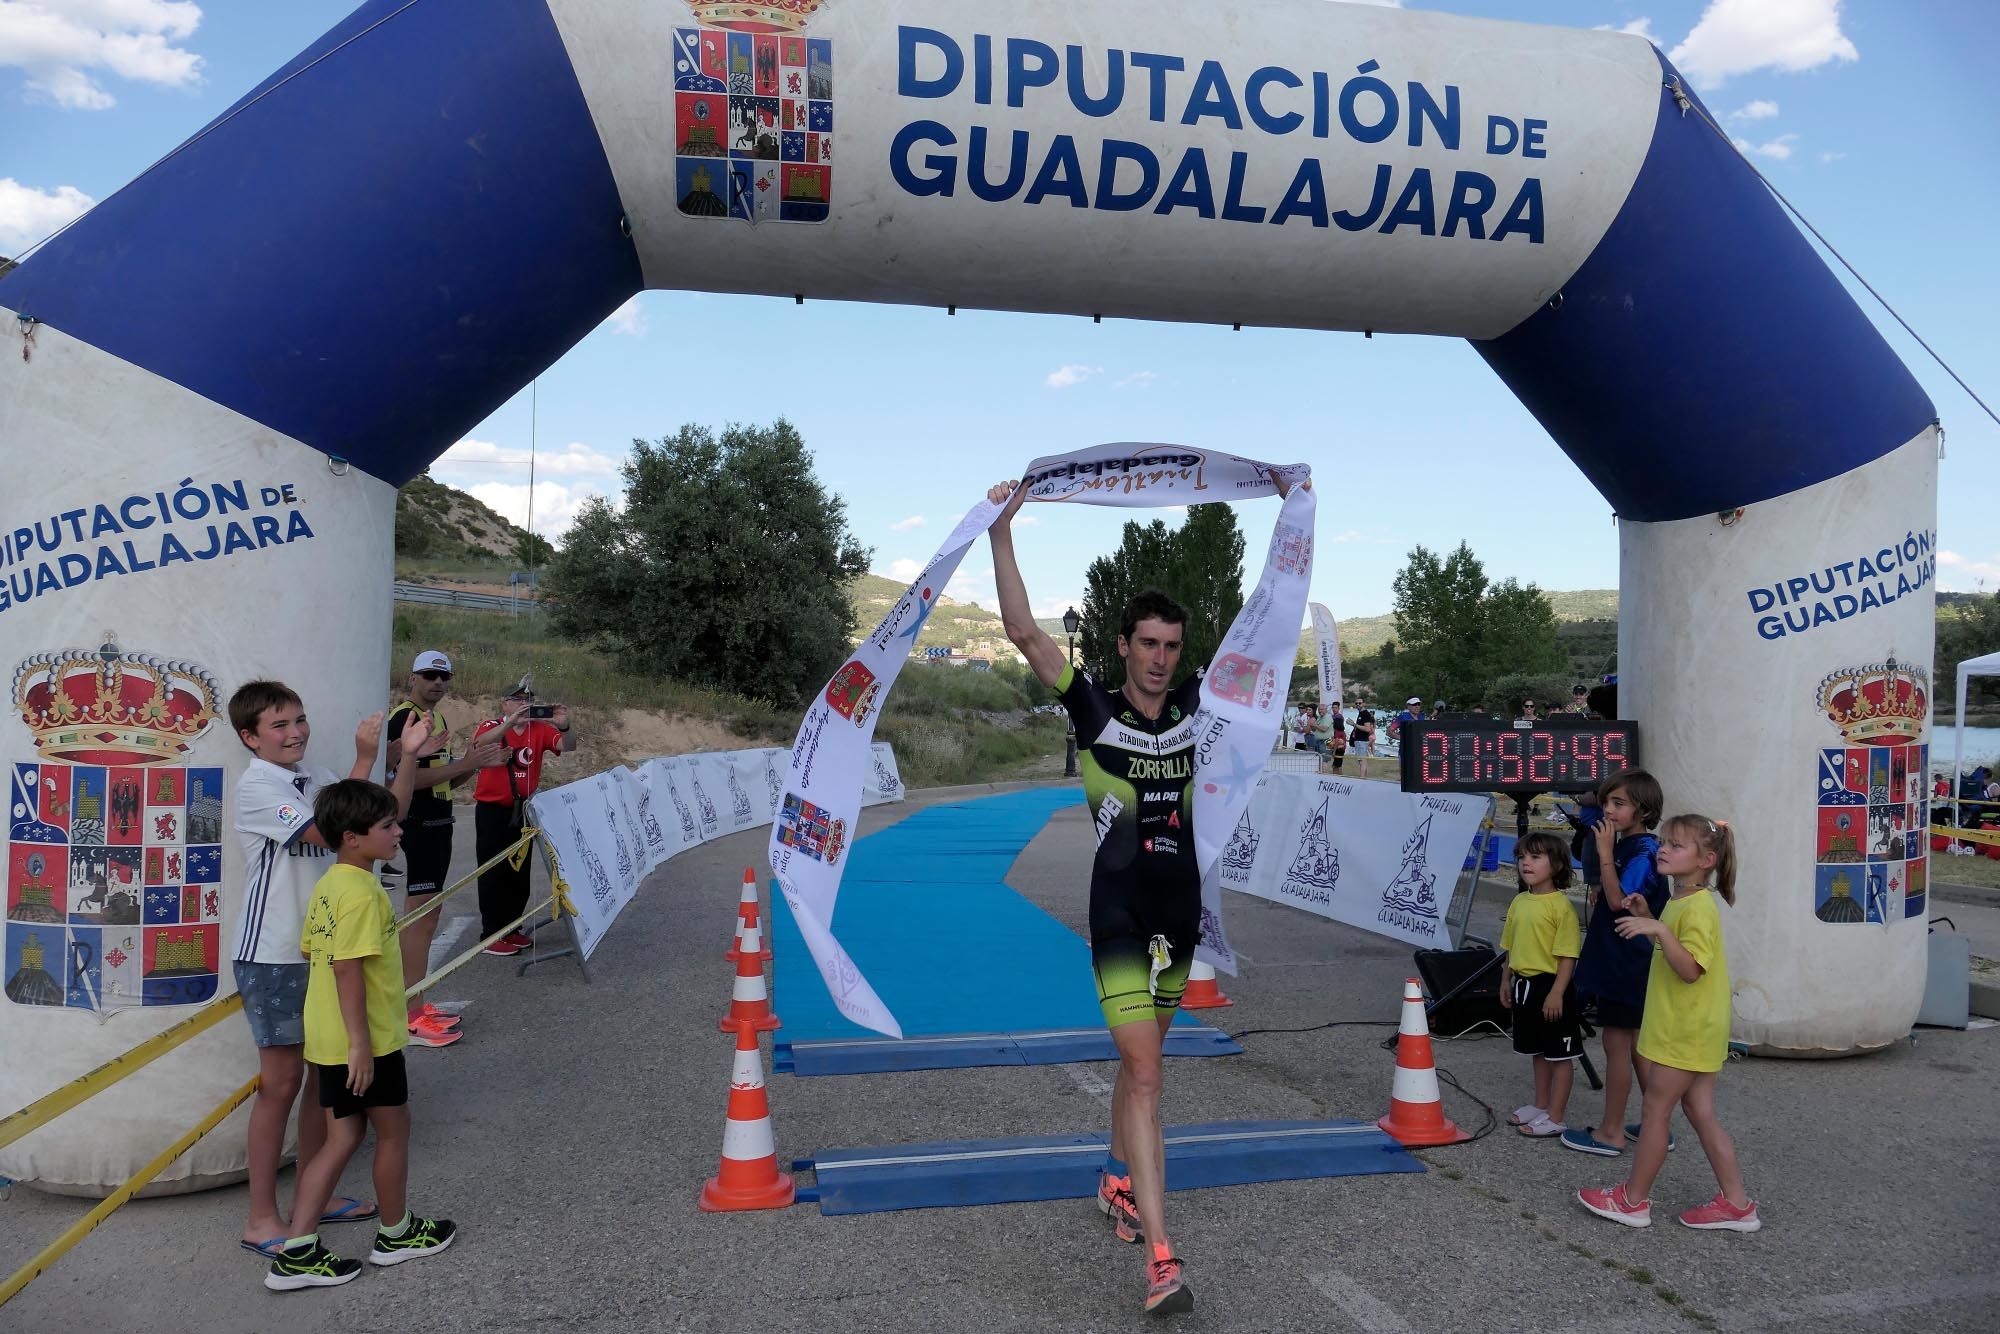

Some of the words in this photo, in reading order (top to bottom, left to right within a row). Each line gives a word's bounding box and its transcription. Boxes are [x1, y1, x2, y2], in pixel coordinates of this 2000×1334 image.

[898, 25, 1461, 150] DIPUTACIÓN
[1486, 114, 1548, 159] DE
[889, 119, 1545, 244] GUADALAJARA
[260, 484, 297, 507] DE
[1747, 529, 1930, 614] DIPUTACIÓN
[1757, 554, 1937, 641] GUADALAJAR
[802, 705, 830, 788] Ayuntamiento
[1119, 731, 1150, 750] STADIUM
[1127, 755, 1192, 780] ZORRILLA
[1562, 1036, 1572, 1052] 7
